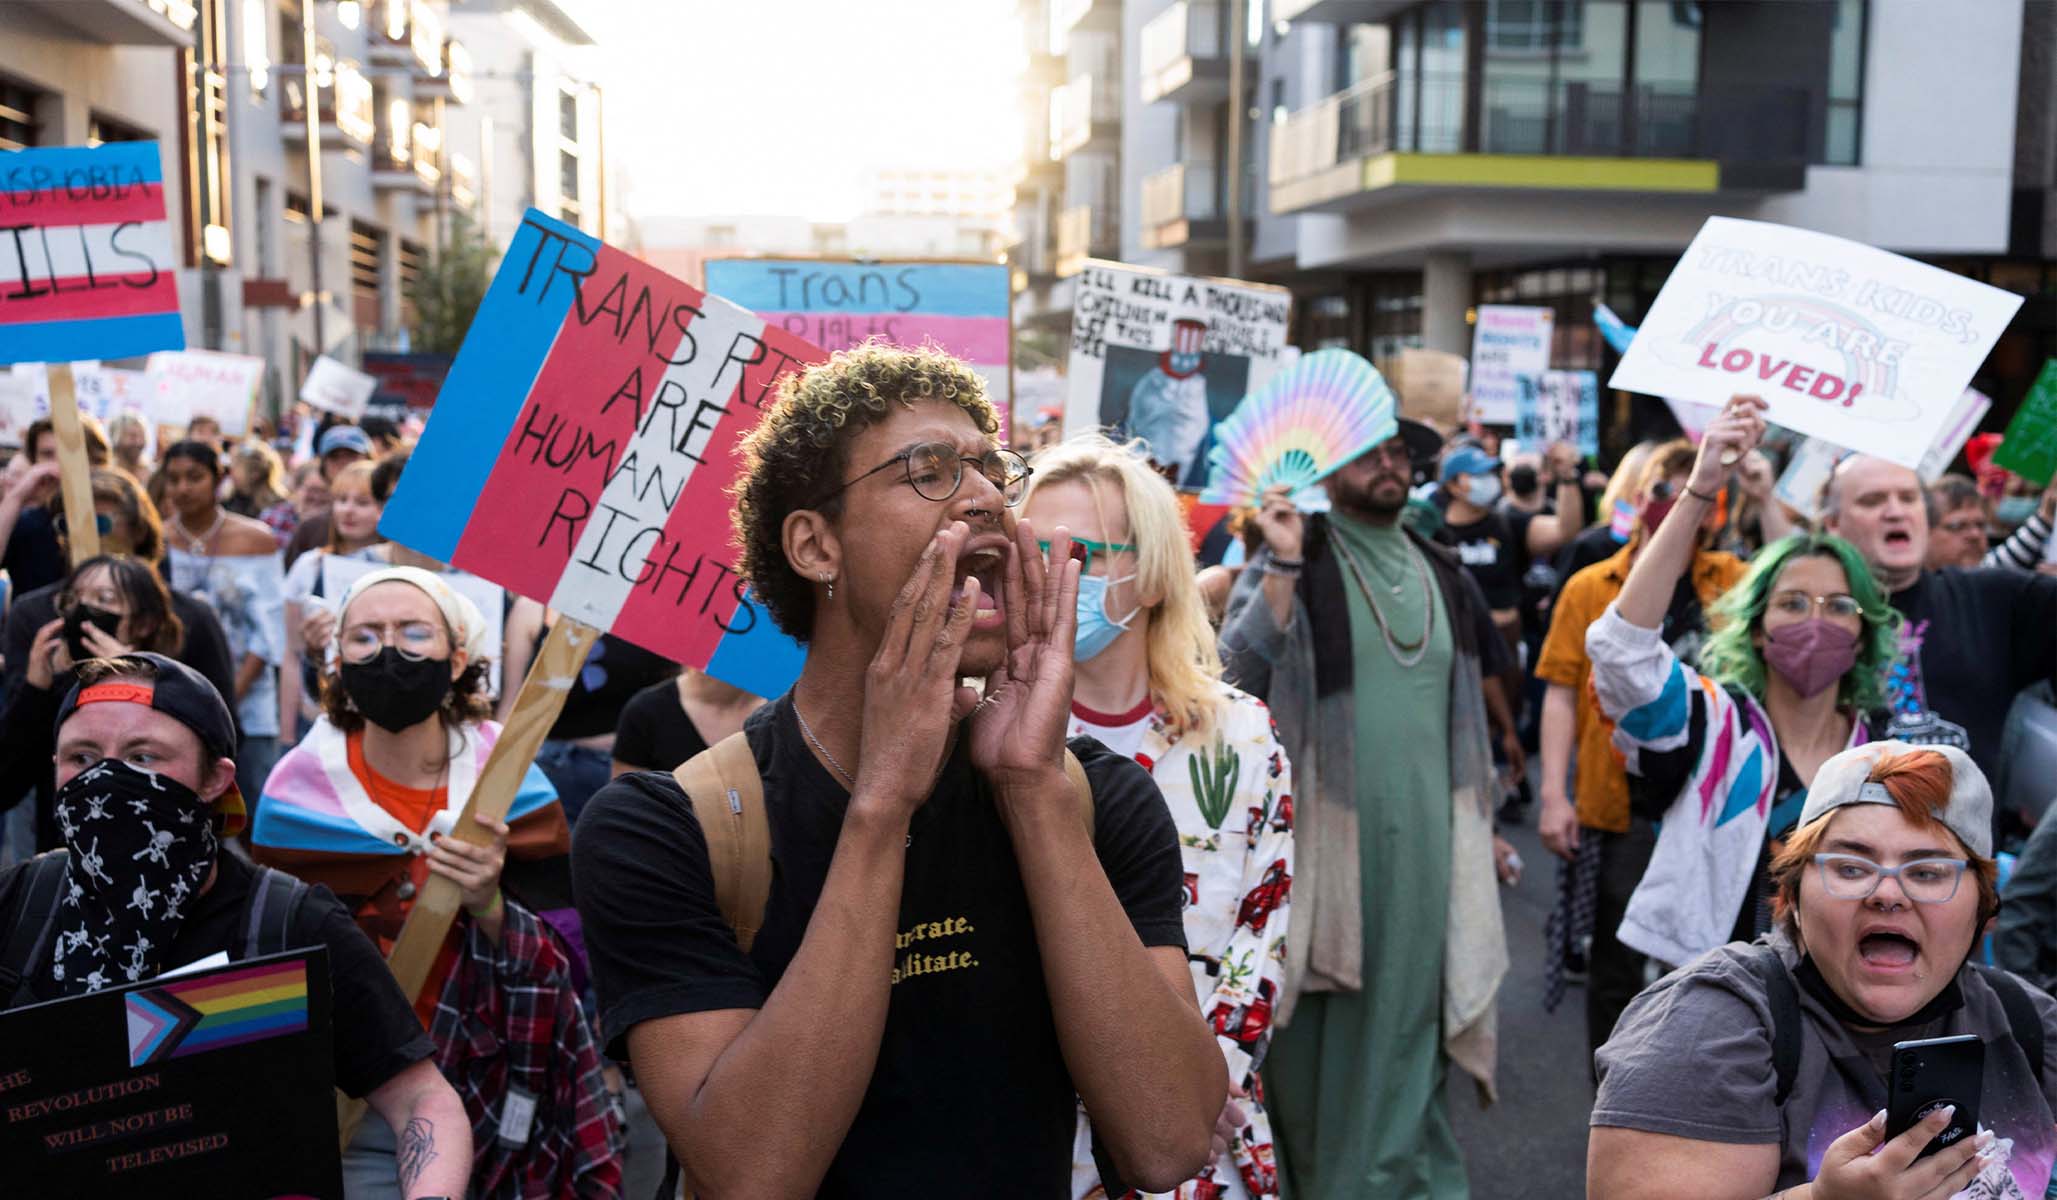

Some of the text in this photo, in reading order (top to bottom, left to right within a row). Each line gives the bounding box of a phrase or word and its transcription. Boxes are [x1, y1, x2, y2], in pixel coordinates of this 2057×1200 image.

[0, 221, 158, 299] ILLS
[767, 266, 922, 313] Trans
[1131, 277, 1171, 301] KILL
[1182, 285, 1199, 305] A
[1697, 246, 1980, 345] TRANS KIDS,
[517, 219, 804, 410] TRANS RI
[1706, 291, 1911, 366] YOU ARE
[1697, 342, 1863, 408] LOVED!
[600, 367, 733, 466] ARE
[514, 403, 686, 514] HUMAN
[538, 487, 757, 634] RIGHTS
[8, 1073, 160, 1122] REVOLUTION
[43, 1103, 193, 1149] WILL NOT BE
[106, 1133, 229, 1173] TELEVISED
